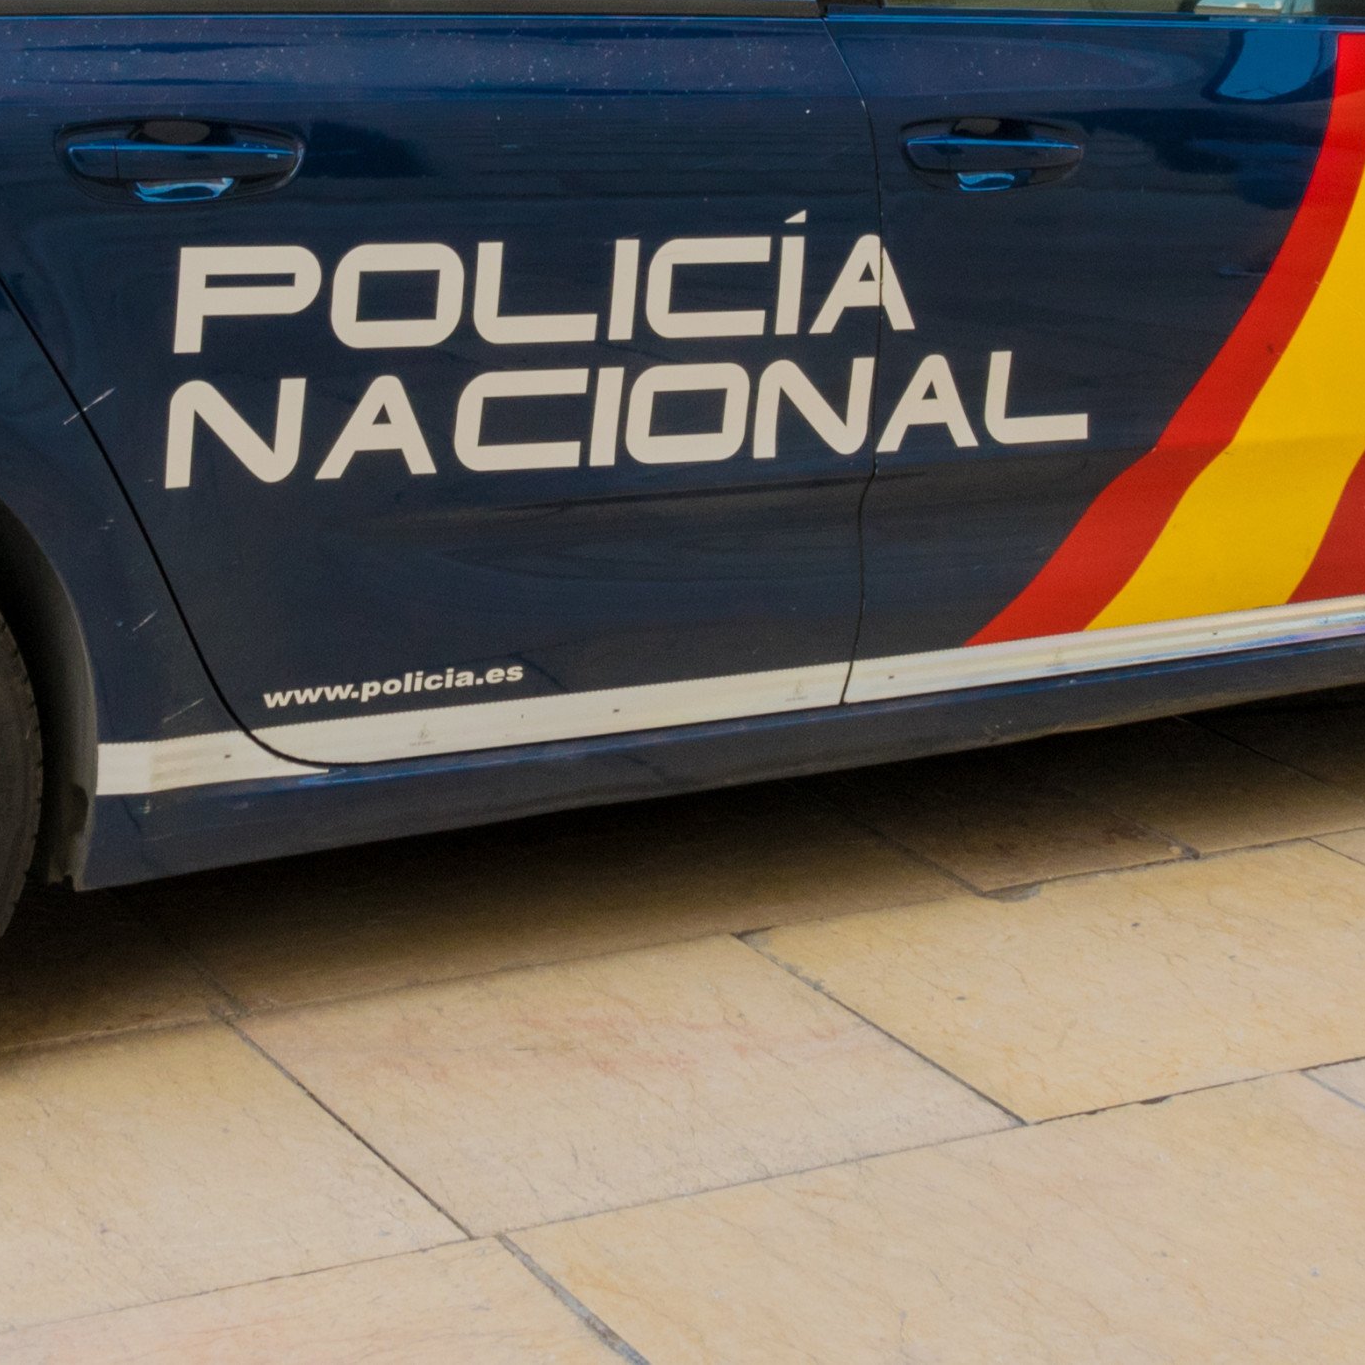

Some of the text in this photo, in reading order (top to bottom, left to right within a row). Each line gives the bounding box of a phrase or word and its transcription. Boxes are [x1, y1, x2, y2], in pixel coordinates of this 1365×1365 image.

[174, 209, 916, 354] POLICÍA
[165, 350, 1089, 489] NACIONAL
[263, 664, 524, 709] www.policia.es
